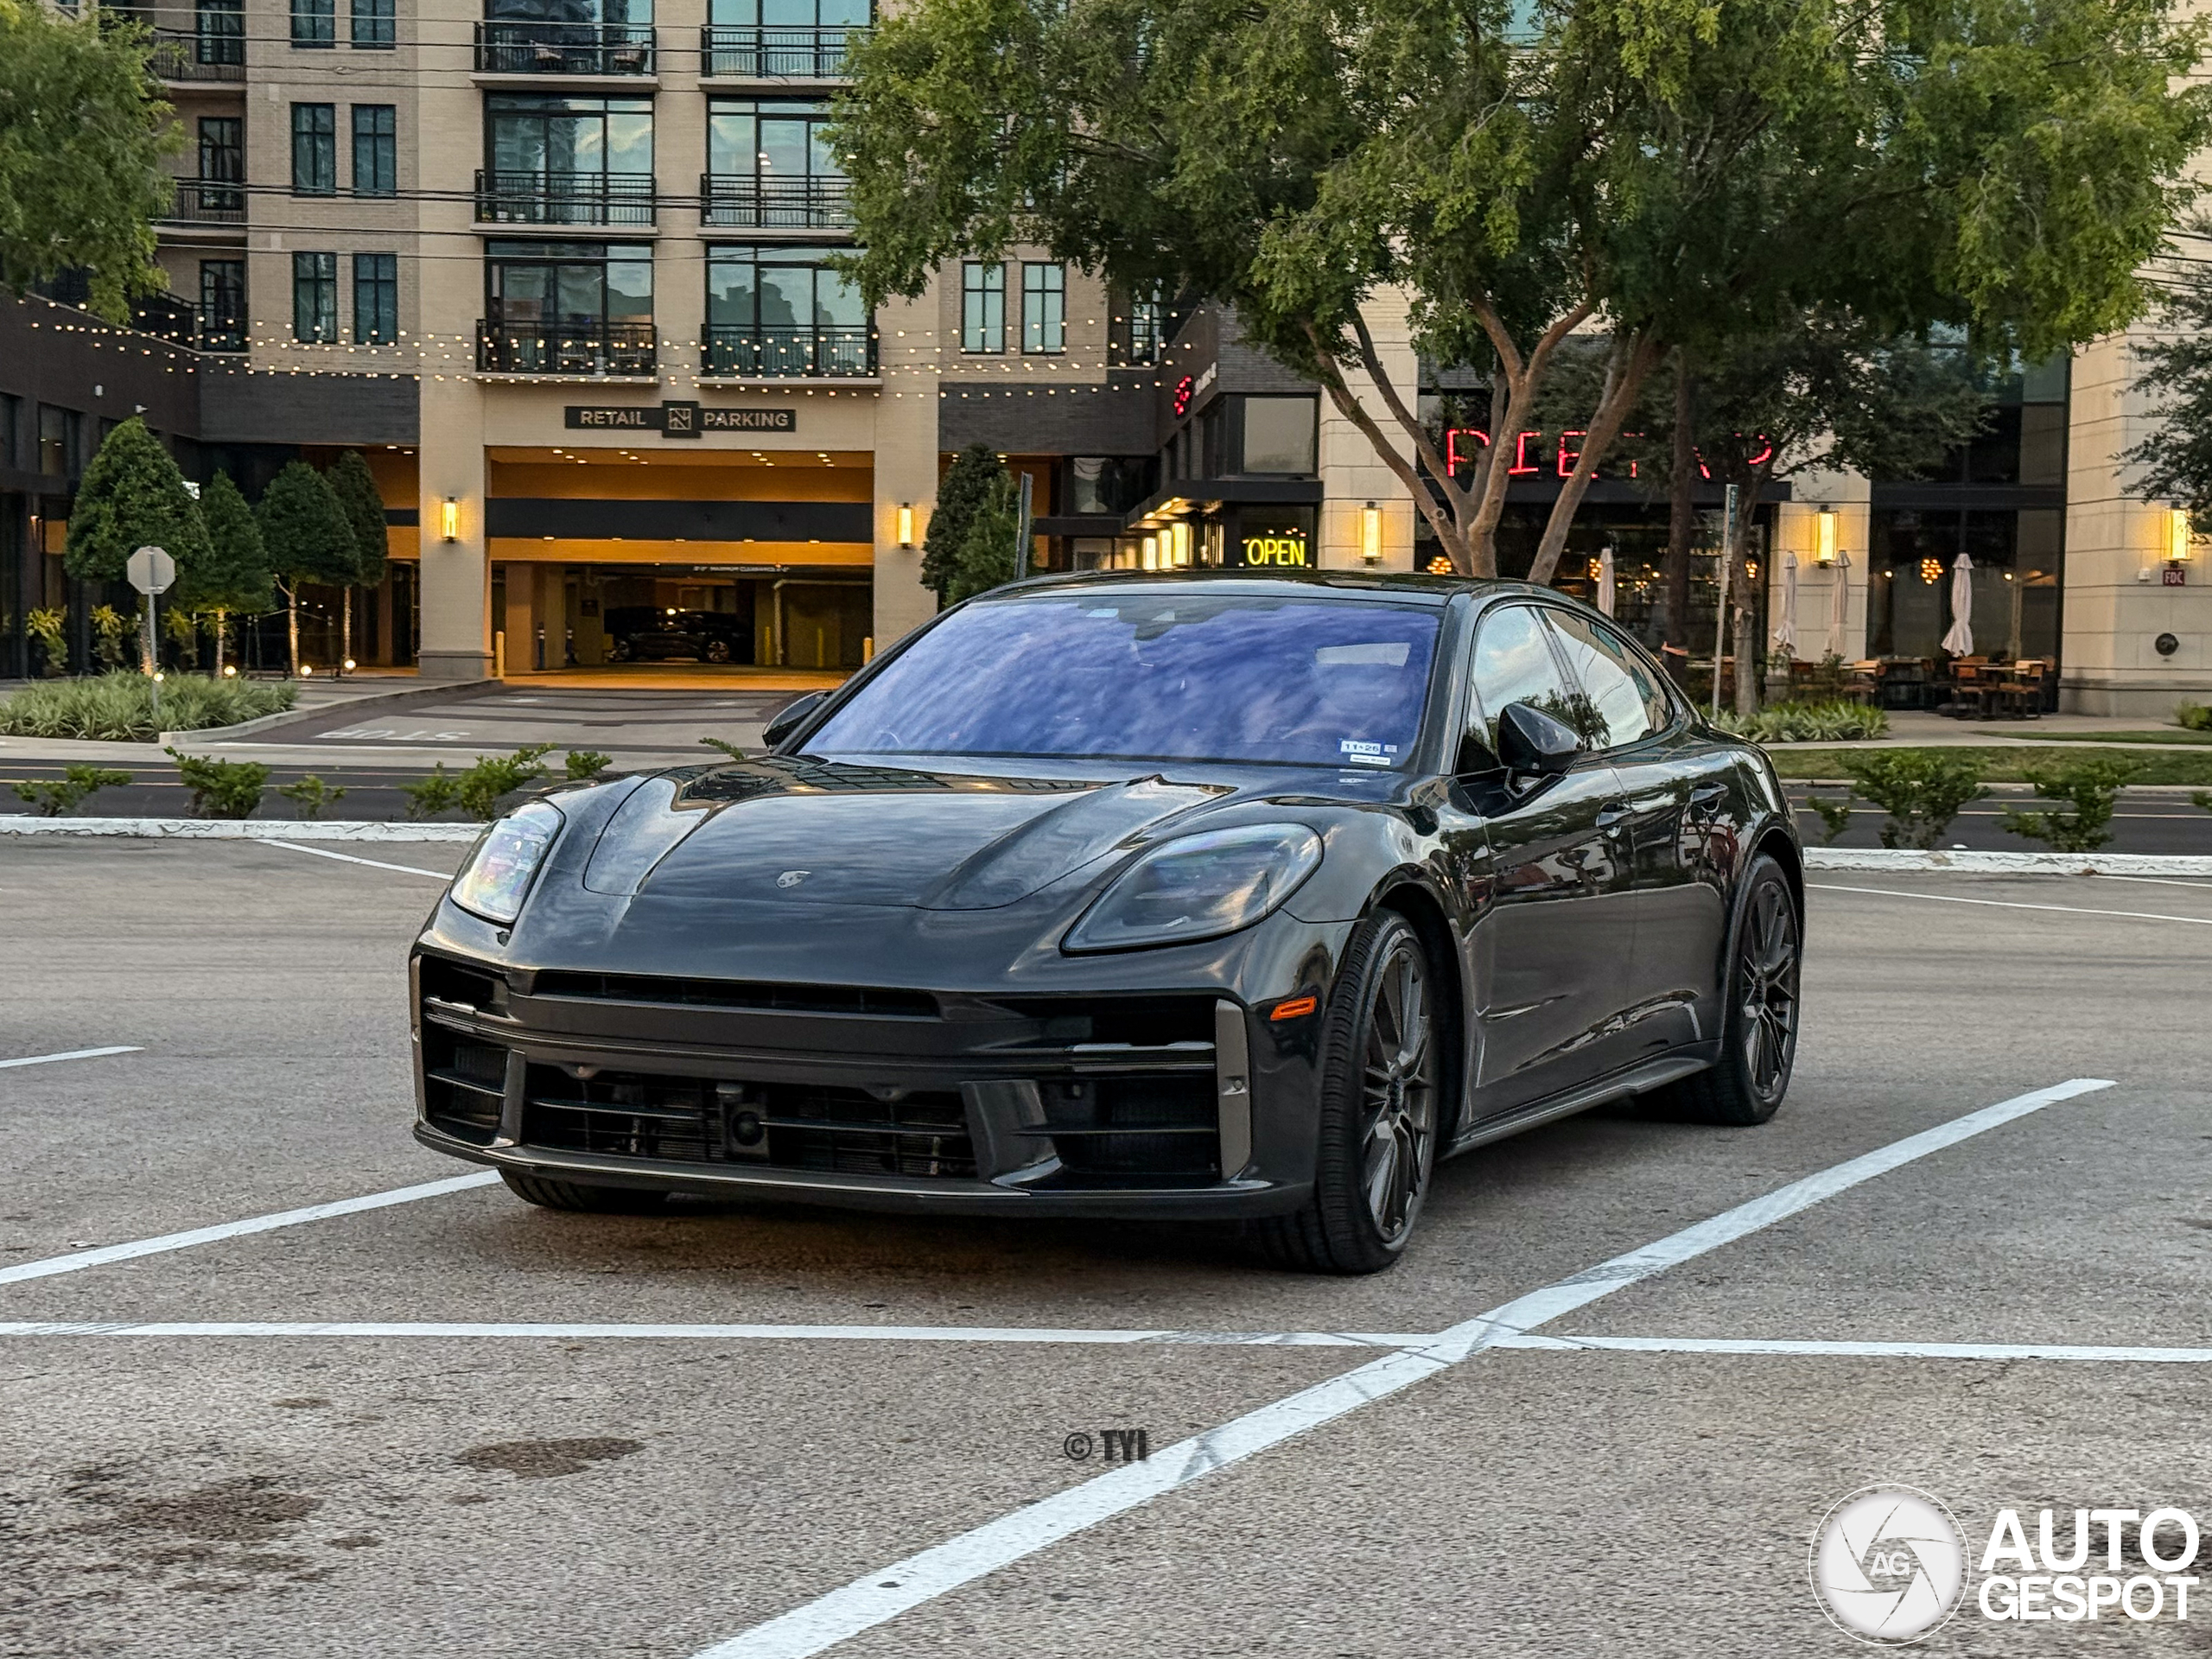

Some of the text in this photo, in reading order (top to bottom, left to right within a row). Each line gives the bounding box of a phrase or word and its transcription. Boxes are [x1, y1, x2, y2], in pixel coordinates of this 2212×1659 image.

[580, 410, 646, 425] RETAIL
[703, 412, 789, 428] PARKING
[1248, 539, 1305, 566] OPEN
[2164, 571, 2183, 584] FDC
